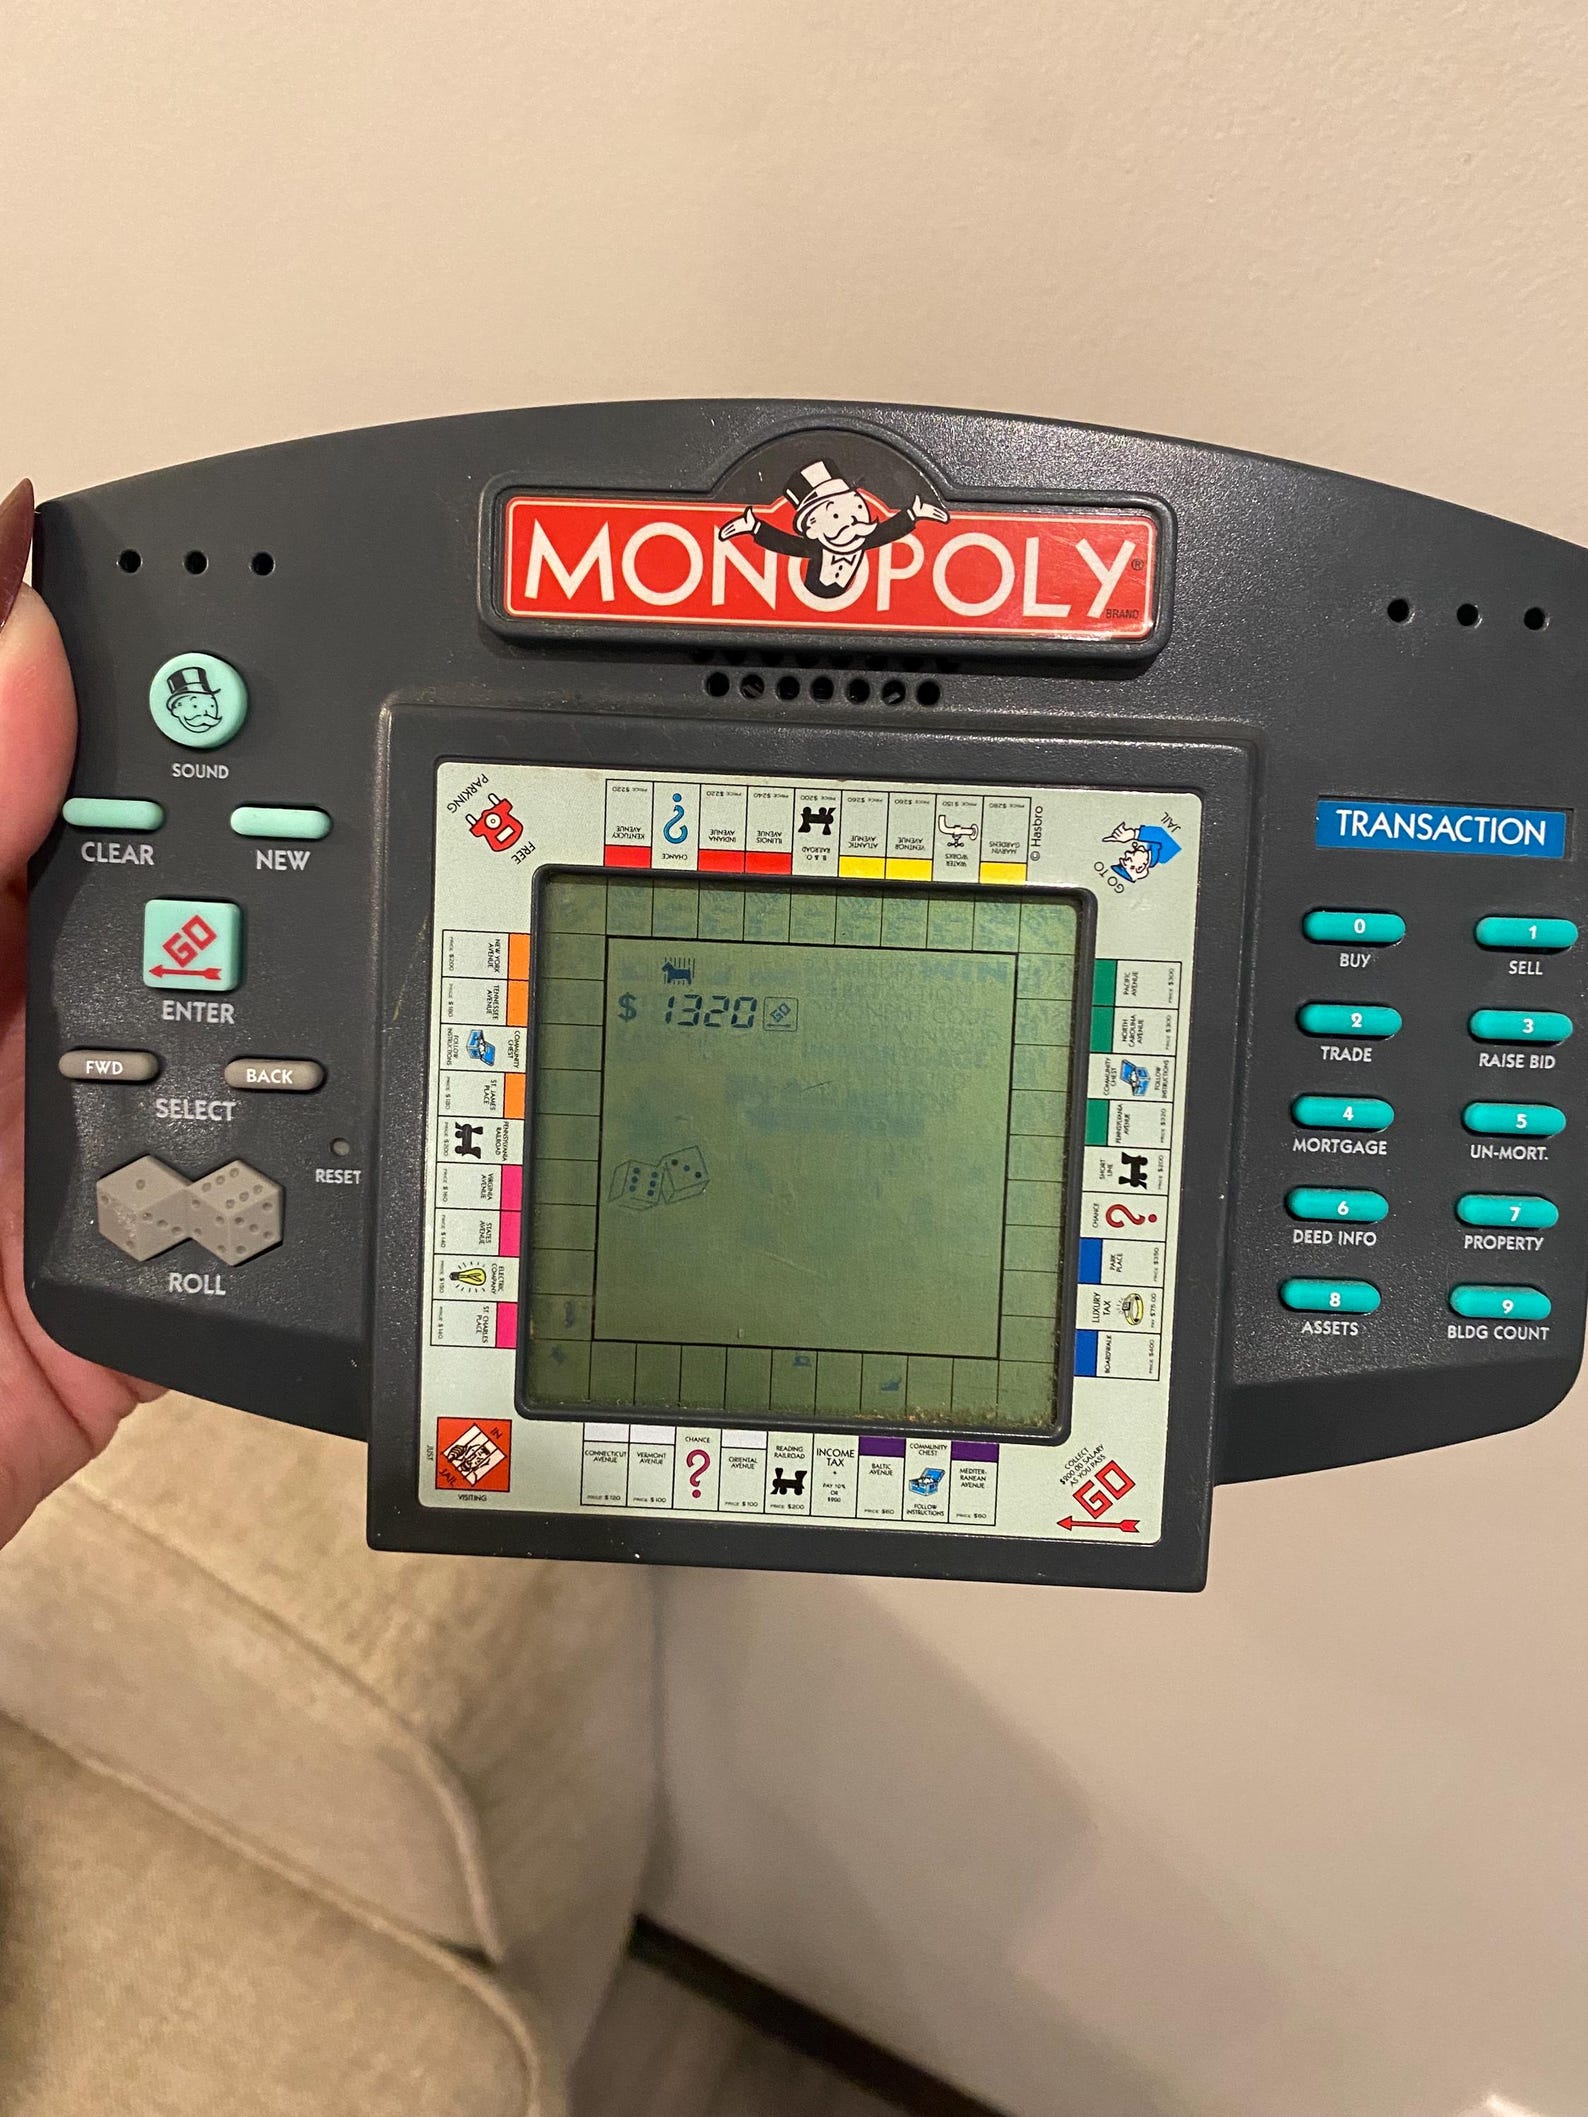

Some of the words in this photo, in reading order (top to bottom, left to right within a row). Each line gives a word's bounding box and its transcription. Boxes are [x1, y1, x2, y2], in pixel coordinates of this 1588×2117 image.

[524, 519, 1135, 619] MONOPOLY
[1105, 608, 1139, 620] BRAND
[172, 763, 229, 780] SOUND
[446, 773, 489, 814] PARKING
[1031, 806, 1043, 847] Hasbro
[1160, 811, 1181, 833] JAIL
[1335, 809, 1546, 846] TRANSACTION
[612, 832, 645, 840] KENTUCKY
[709, 835, 736, 843] INDIANA
[81, 841, 154, 866] CLEAR
[256, 850, 310, 871] NEW
[511, 841, 536, 865] FREE
[1094, 861, 1109, 878] TO
[1107, 876, 1125, 893] GO
[1354, 918, 1366, 934] 0
[1528, 925, 1538, 940] 1
[162, 914, 217, 967] GO
[1339, 953, 1371, 968] BUY
[1508, 961, 1543, 975] SELL
[161, 1000, 235, 1025] ENTER
[617, 992, 637, 1023] $
[664, 994, 757, 1028] 1320
[770, 1003, 791, 1024] GO
[1351, 1013, 1363, 1028] 2
[1522, 1018, 1534, 1034] 3
[513, 1030, 521, 1068] COMMUNITY
[1320, 1046, 1372, 1063] TRADE
[85, 1060, 124, 1076] FWD
[1479, 1053, 1524, 1069] RAISE
[1529, 1055, 1556, 1069] BID
[246, 1069, 293, 1084] BACK
[156, 1099, 236, 1121] SELECT
[1343, 1106, 1354, 1121] 4
[1516, 1114, 1527, 1129] 5
[1292, 1138, 1388, 1155] MORTGAGE
[1470, 1145, 1549, 1161] UN-MORT.
[315, 1169, 361, 1184] RESET
[1337, 1201, 1349, 1215] 6
[1509, 1206, 1521, 1222] 7
[1293, 1229, 1333, 1245] DEED
[1338, 1231, 1377, 1246] INFO
[1464, 1235, 1544, 1251] PROPERTY
[169, 1273, 226, 1295] ROLL
[1092, 1292, 1101, 1323] LUXURY
[1103, 1300, 1111, 1316] TAX
[1329, 1292, 1341, 1308] 8
[1502, 1300, 1514, 1314] 9
[1301, 1320, 1359, 1336] ASSETS
[1447, 1325, 1488, 1340] BLDG
[1493, 1326, 1549, 1340] COUNT
[490, 1427, 503, 1439] IN
[426, 1444, 434, 1461] JUST
[585, 1450, 626, 1458] CONNECTICUT
[776, 1445, 803, 1453] READING
[816, 1448, 855, 1458] INCOME
[909, 1443, 948, 1451] COMMUNITY
[1082, 1443, 1105, 1464] SALARY
[593, 1456, 617, 1464] AVENUE
[774, 1452, 805, 1460] RAILROAD
[827, 1458, 844, 1467] TAX
[1065, 1447, 1089, 1470] COLLECT
[439, 1468, 457, 1486] JAIL
[1070, 1477, 1079, 1487] AS
[1078, 1466, 1092, 1479] YOU
[1090, 1454, 1106, 1468] PASS
[960, 1481, 985, 1489] AVENUE
[1072, 1460, 1136, 1520] GO
[906, 1509, 945, 1517] INSTRUCTIONS
